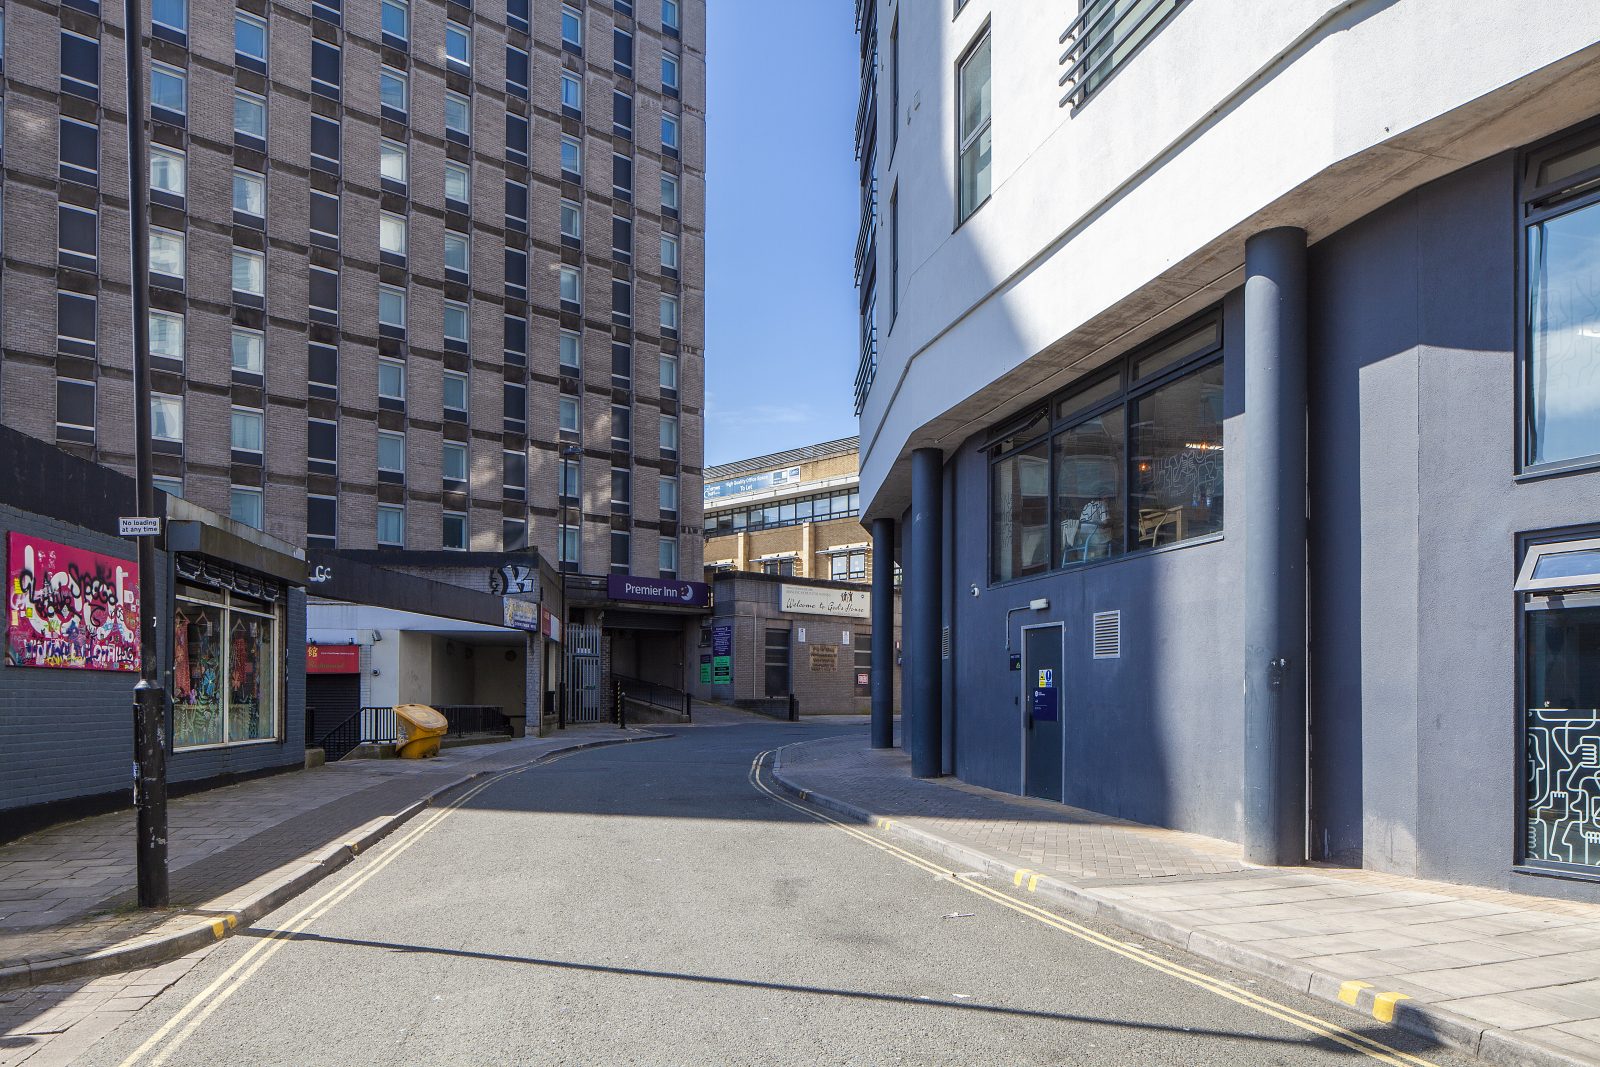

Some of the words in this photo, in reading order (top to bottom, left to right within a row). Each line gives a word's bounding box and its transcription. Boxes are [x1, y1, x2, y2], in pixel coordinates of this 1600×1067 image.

[624, 583, 662, 596] Premier
[663, 586, 678, 598] Inn
[786, 598, 816, 609] Welcome
[819, 602, 826, 610] to
[845, 602, 865, 613] House
